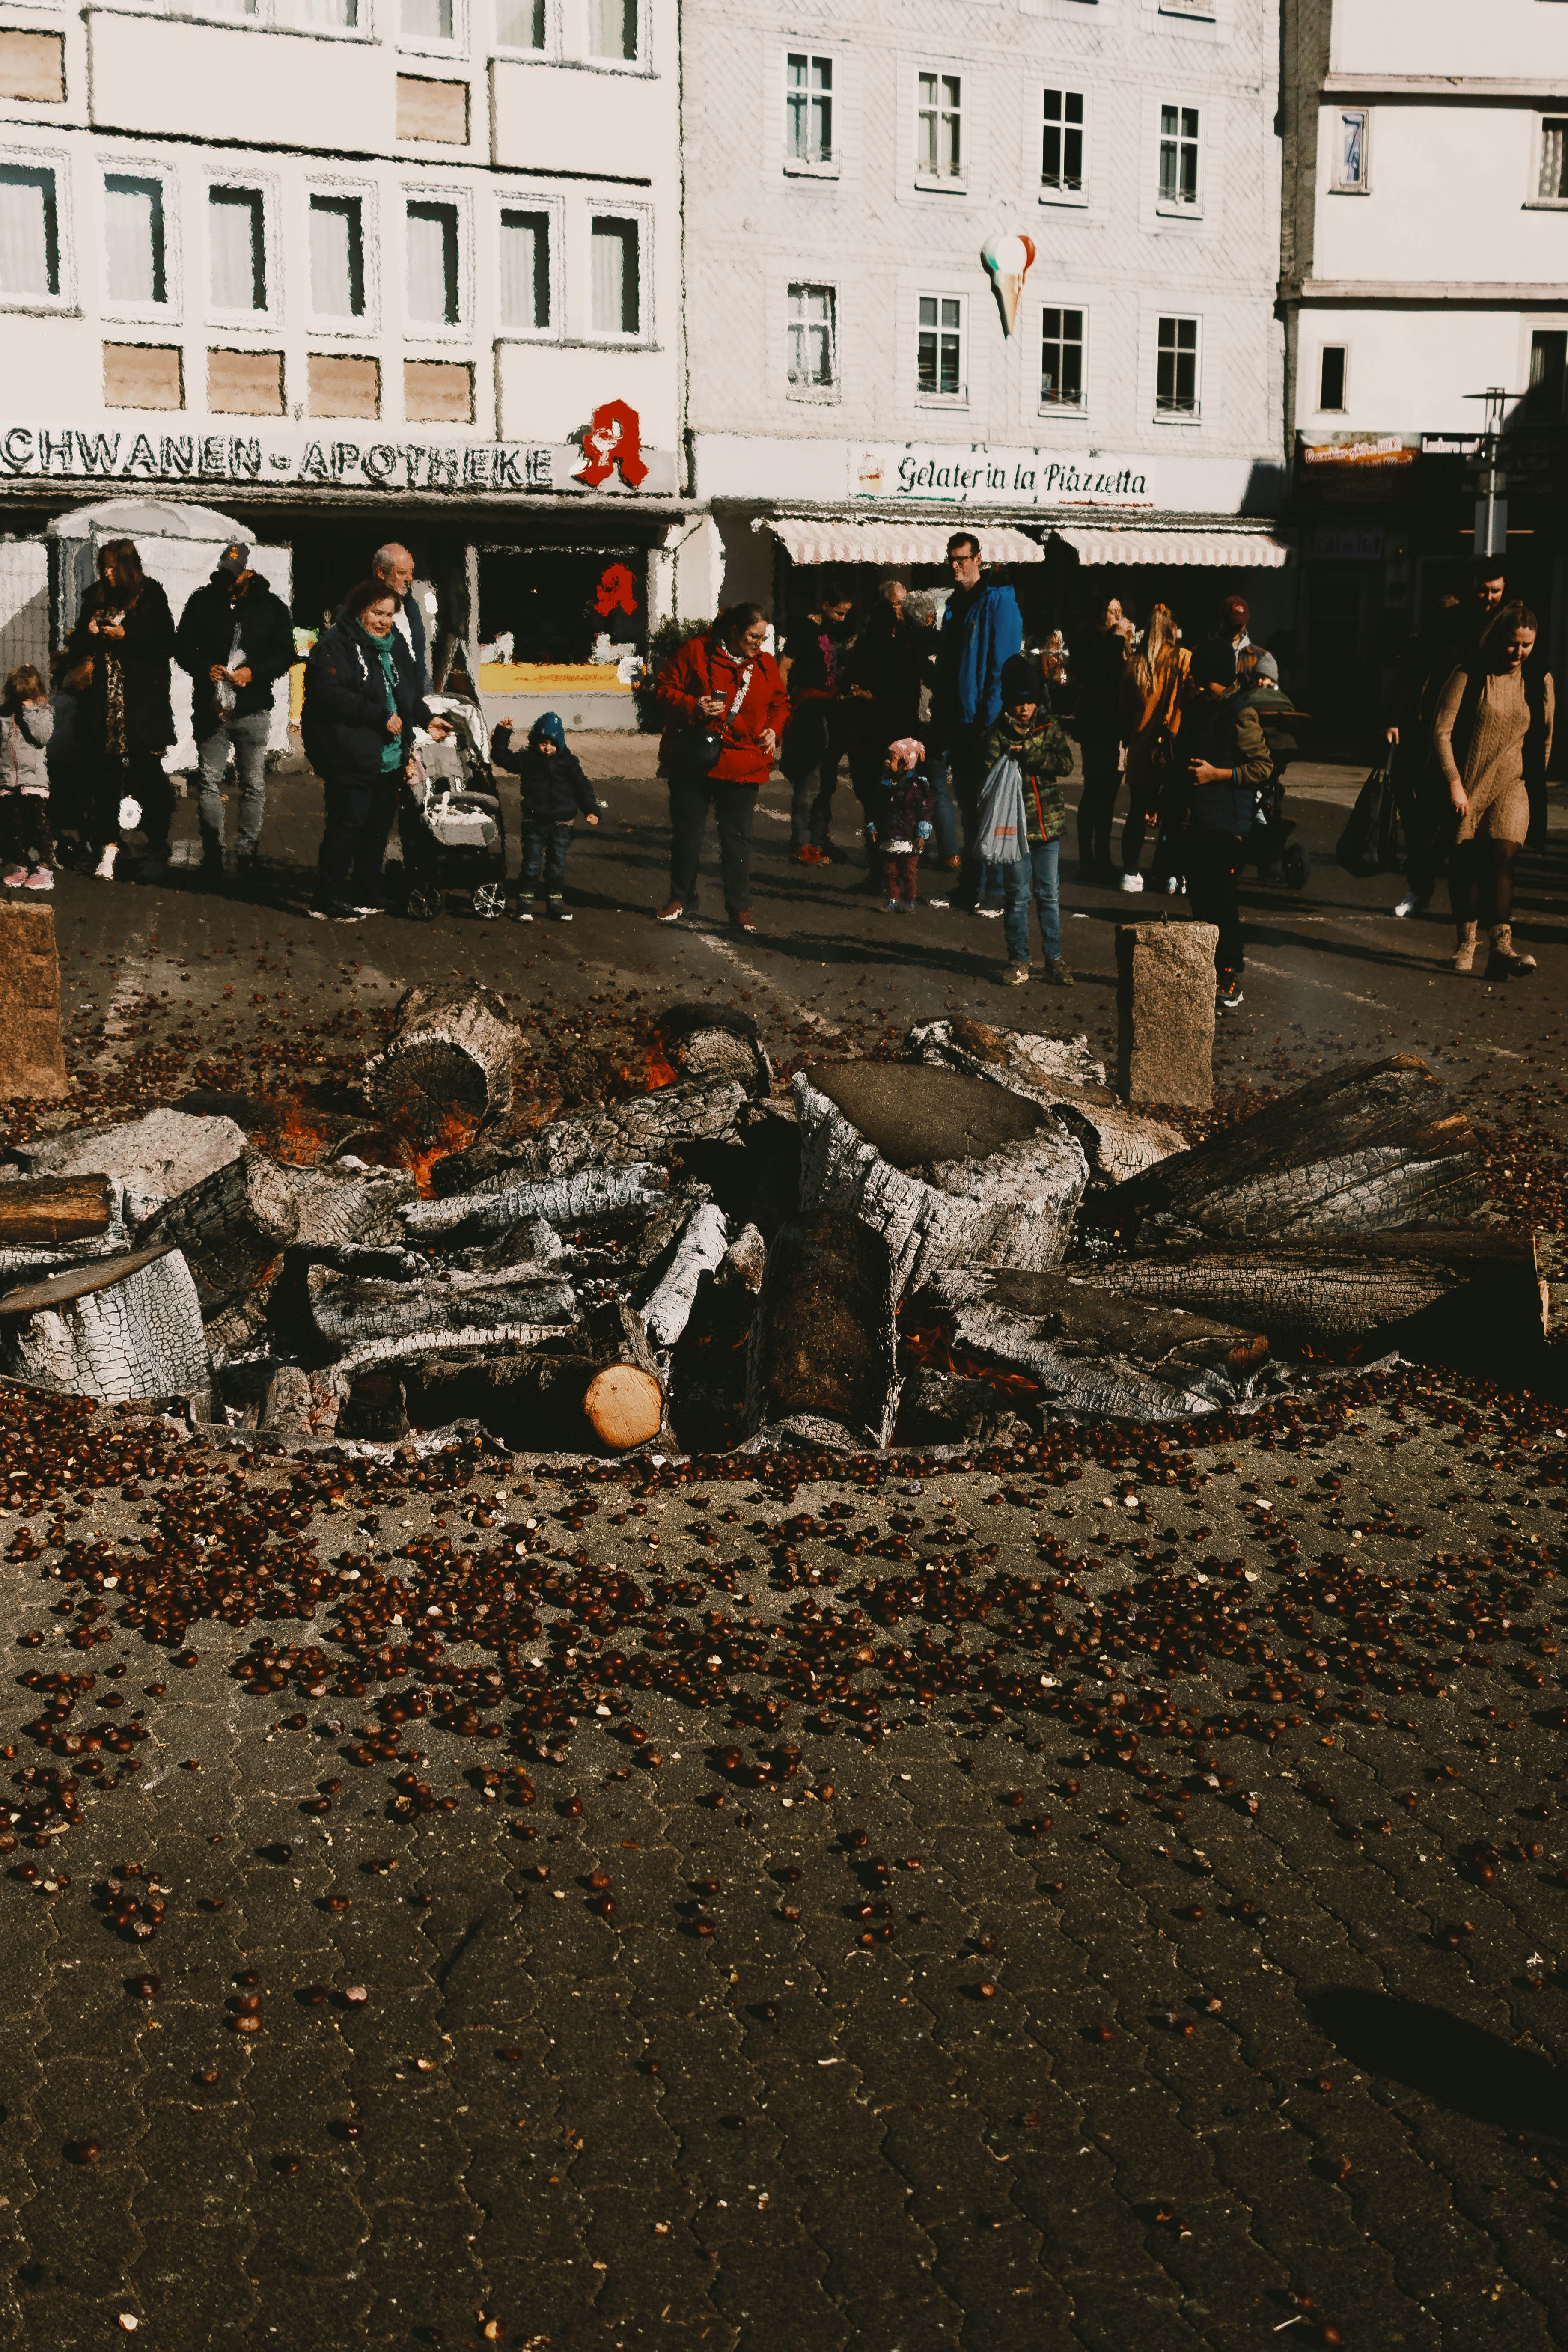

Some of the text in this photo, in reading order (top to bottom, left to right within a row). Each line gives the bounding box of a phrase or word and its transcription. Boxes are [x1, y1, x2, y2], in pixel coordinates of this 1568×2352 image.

[897, 456, 1146, 494] Gelateria la Piazzetta
